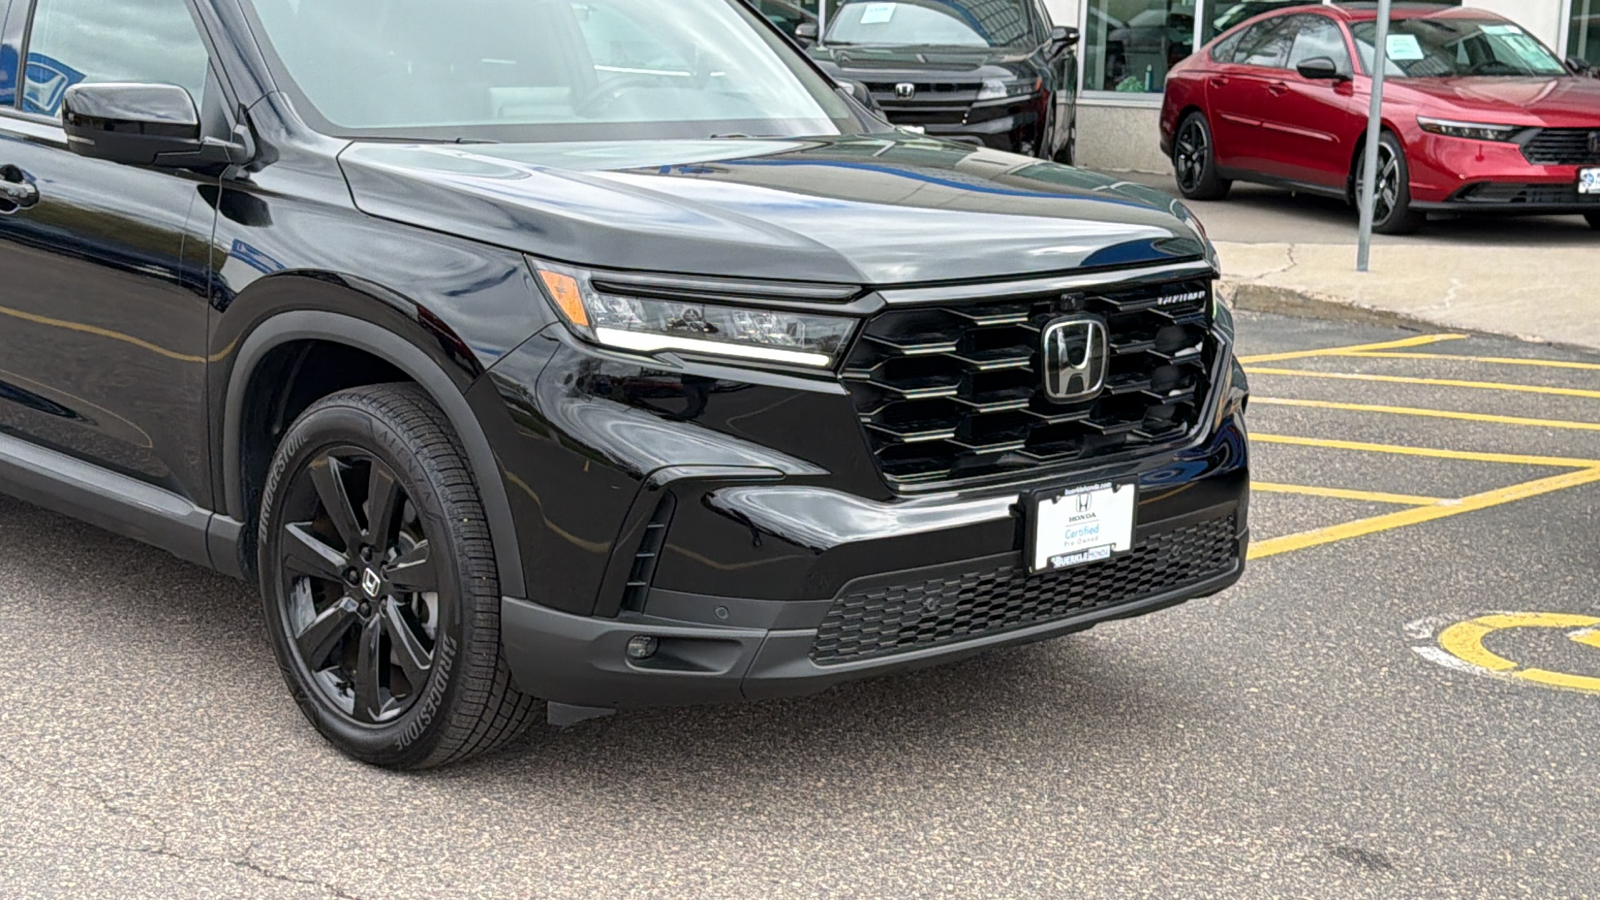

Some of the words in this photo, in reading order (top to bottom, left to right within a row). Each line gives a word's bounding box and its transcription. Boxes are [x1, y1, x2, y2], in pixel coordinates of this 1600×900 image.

[1069, 512, 1096, 522] HONDA
[1064, 524, 1099, 539] Certified
[394, 631, 458, 751] BRIDGESTONE
